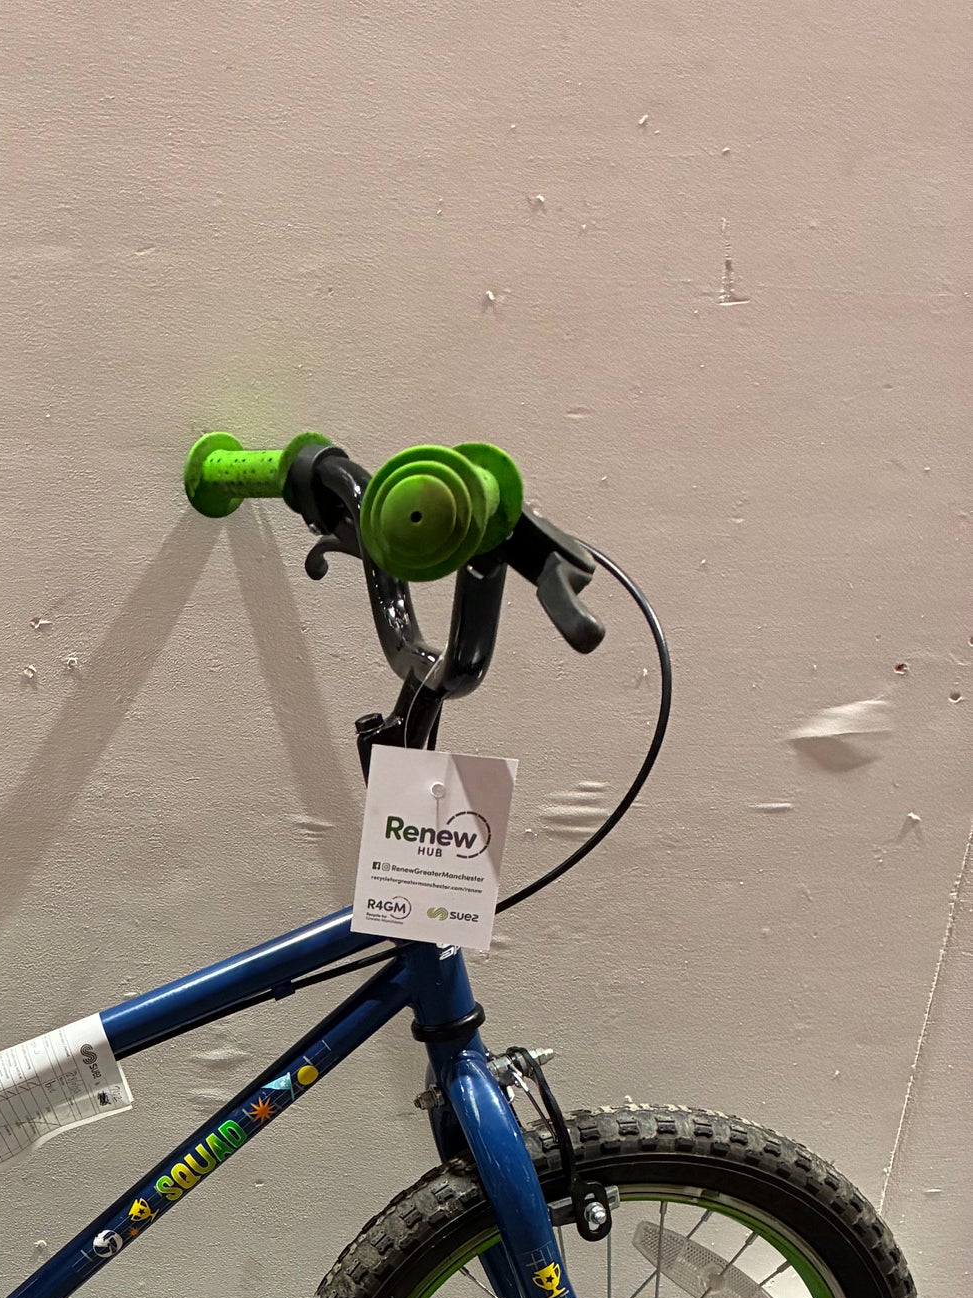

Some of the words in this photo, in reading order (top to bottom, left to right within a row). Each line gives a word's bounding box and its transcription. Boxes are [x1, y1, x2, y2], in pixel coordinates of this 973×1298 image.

[385, 815, 477, 849] Renew
[417, 846, 442, 857] HUB
[391, 865, 484, 883] RenewGreaterManchester
[367, 898, 406, 914] R4GM
[449, 910, 479, 922] suez
[156, 1119, 247, 1200] SQUAD
